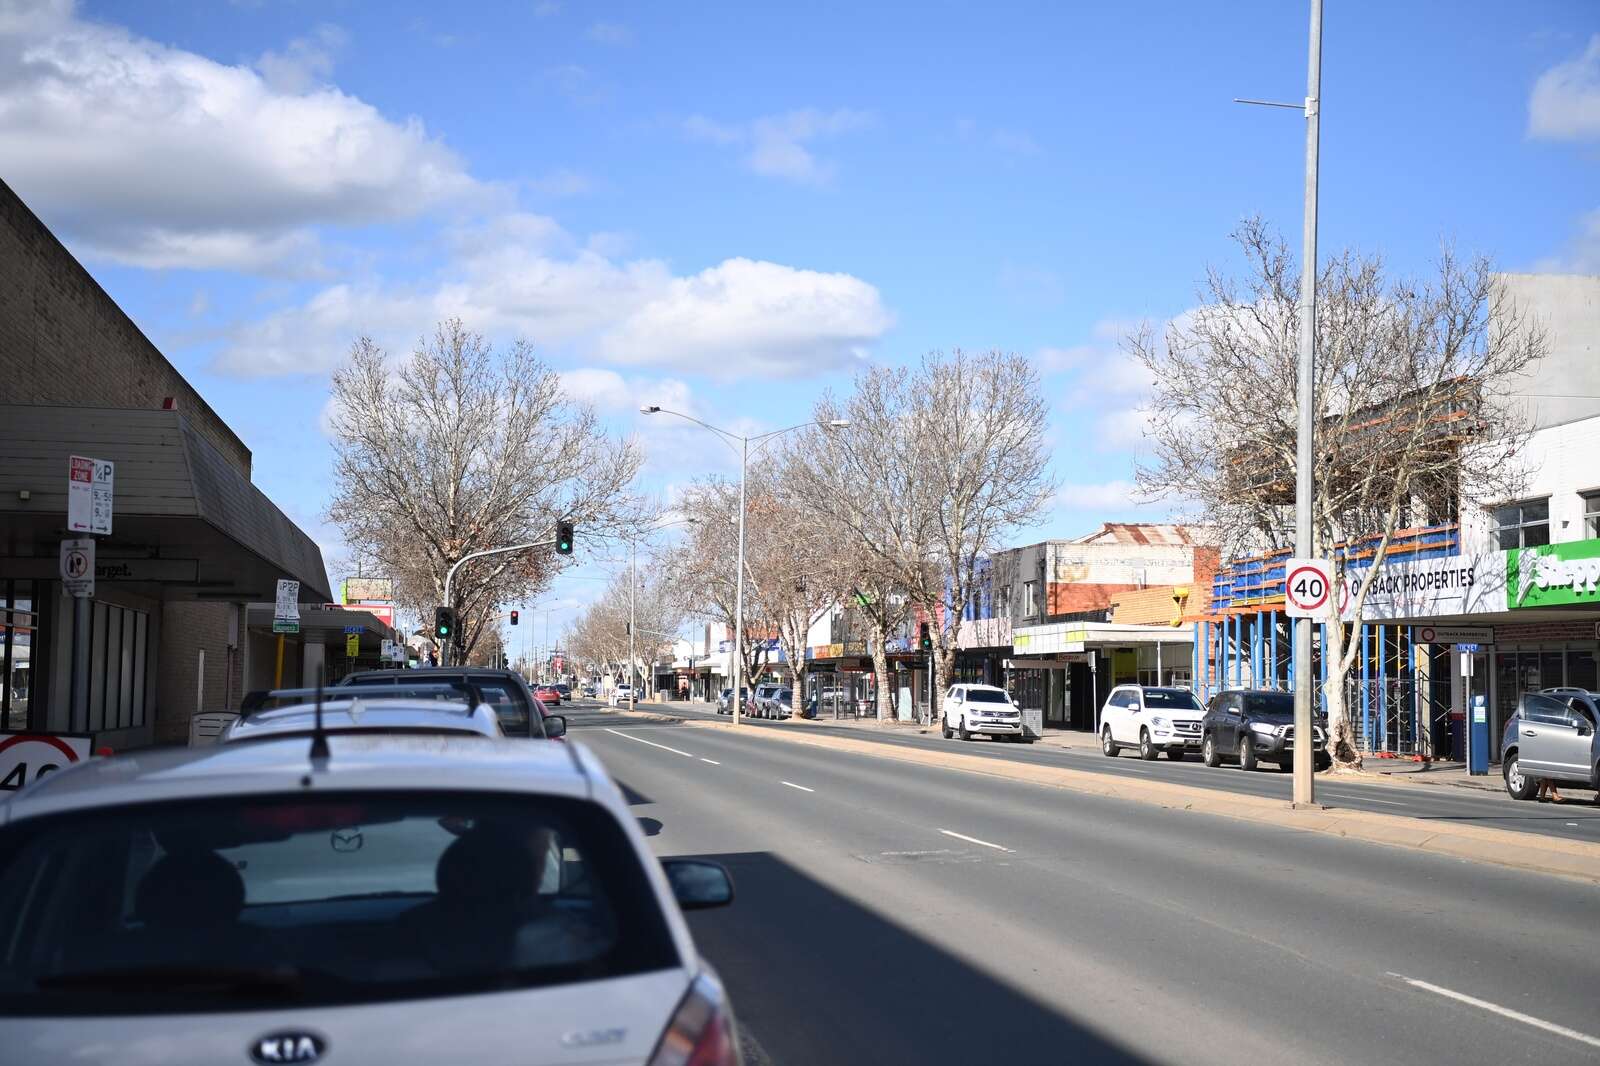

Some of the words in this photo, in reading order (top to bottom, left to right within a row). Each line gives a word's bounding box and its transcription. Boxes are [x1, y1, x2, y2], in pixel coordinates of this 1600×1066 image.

[95, 563, 132, 579] arget.
[1294, 579, 1322, 598] 40
[1352, 575, 1400, 597] OBACK
[1403, 567, 1475, 592] PROPERTIES
[260, 1036, 318, 1060] KIA
